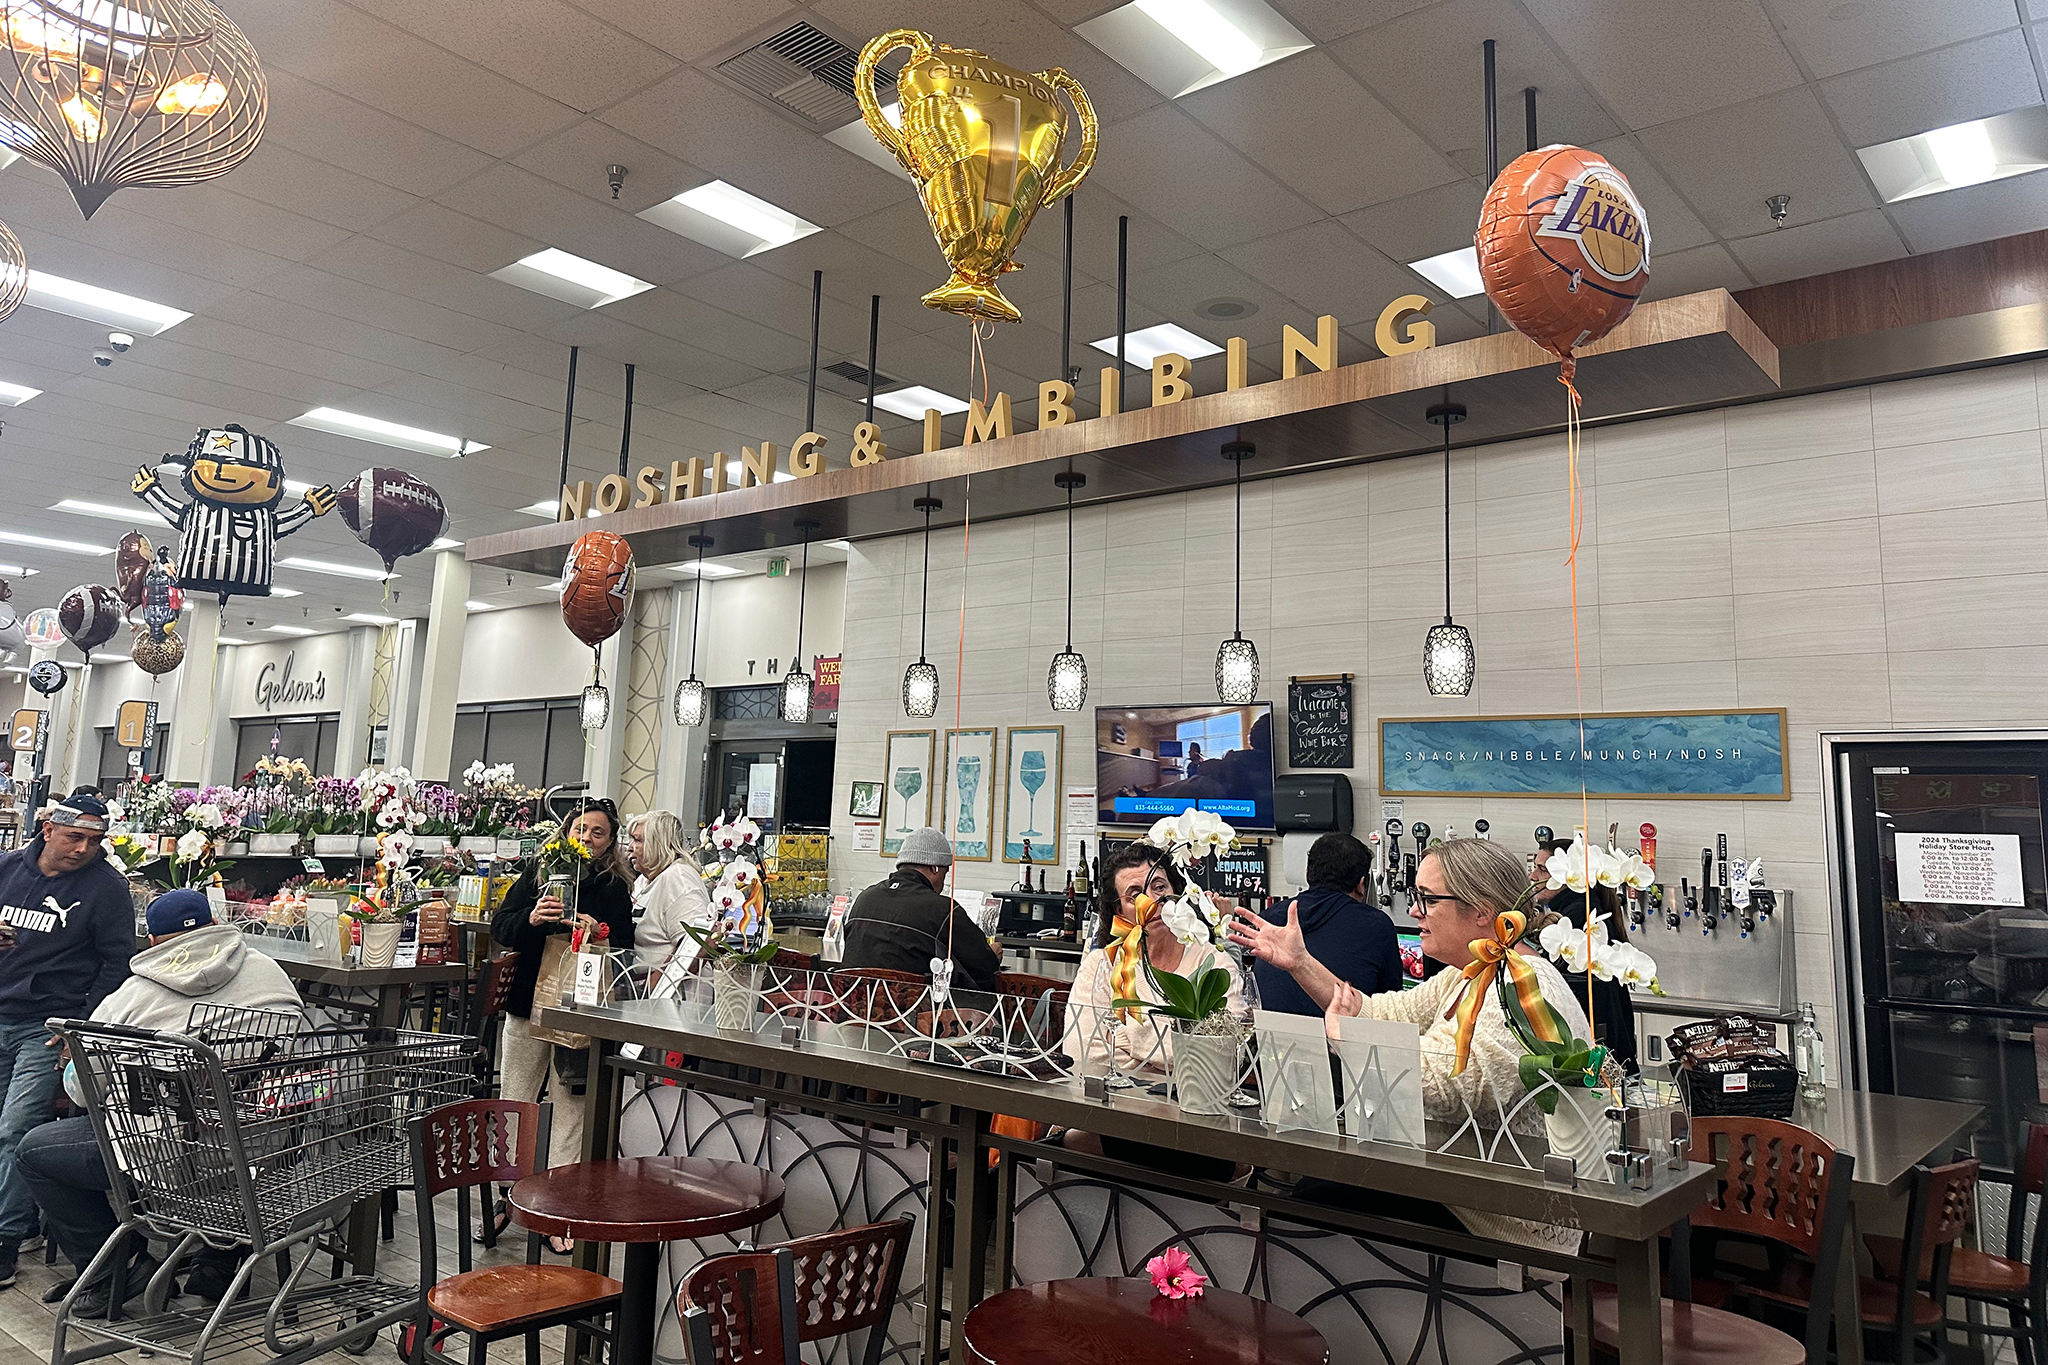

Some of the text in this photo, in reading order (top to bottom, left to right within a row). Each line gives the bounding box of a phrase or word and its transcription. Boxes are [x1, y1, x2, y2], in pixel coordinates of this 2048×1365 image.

[928, 64, 1062, 114] CHAMPION
[1597, 189, 1619, 203] LOS
[560, 294, 1436, 522] NOSHING & IMBIBING
[769, 558, 785, 577] EXIT
[254, 650, 326, 712] Gelson's
[14, 725, 33, 747] 2
[125, 720, 138, 743] 1
[1919, 843, 1947, 851] Holiday
[1942, 837, 1991, 845] Thanksgiving
[1214, 860, 1265, 874] JEOPARDY!
[0, 905, 57, 933] PUMA
